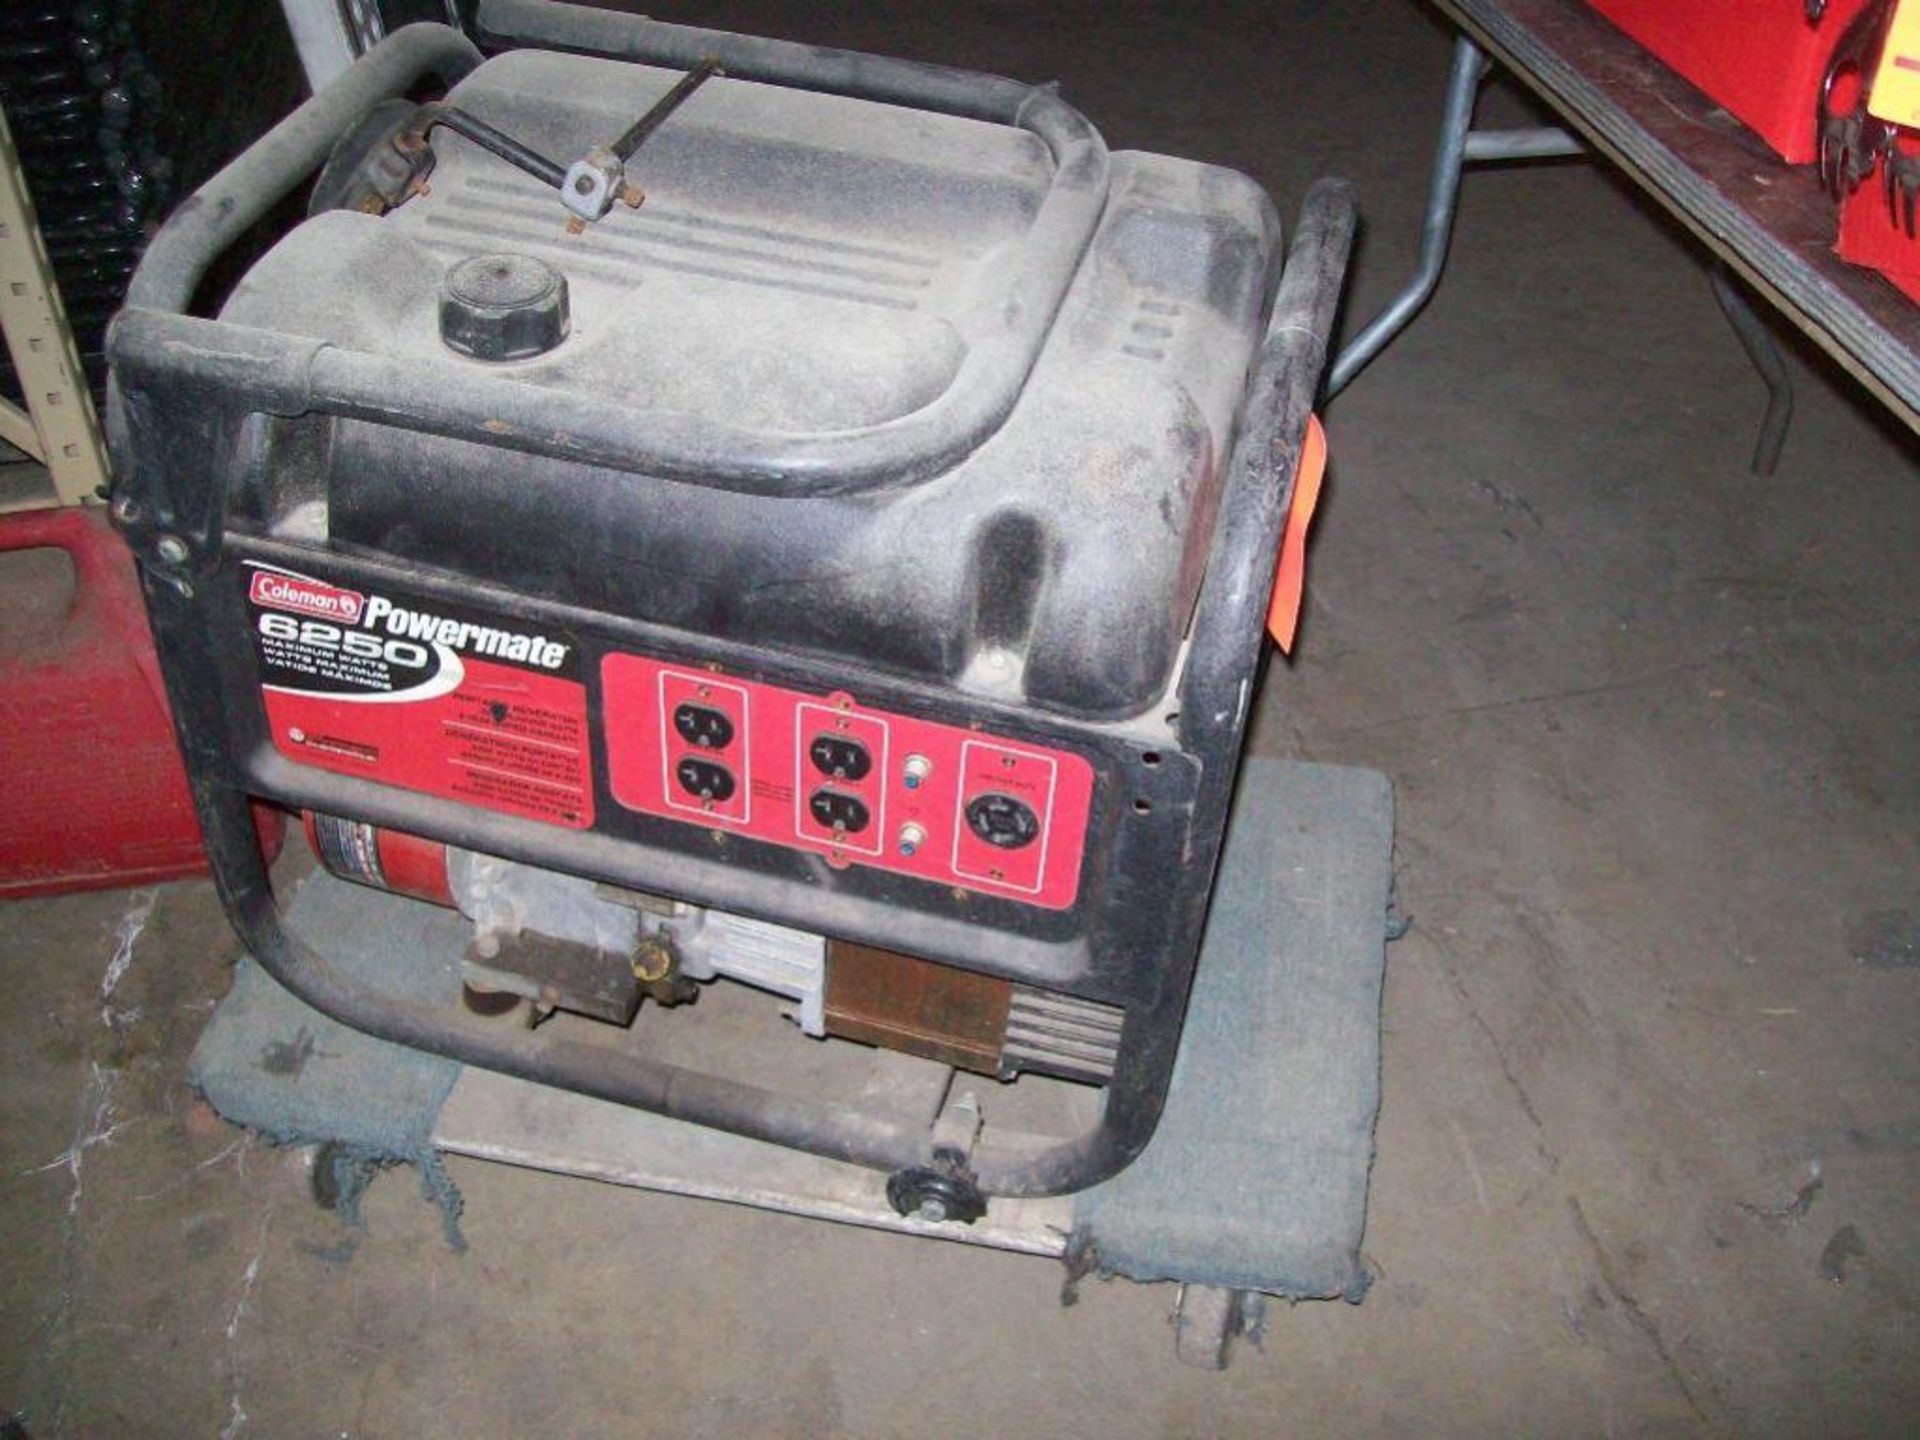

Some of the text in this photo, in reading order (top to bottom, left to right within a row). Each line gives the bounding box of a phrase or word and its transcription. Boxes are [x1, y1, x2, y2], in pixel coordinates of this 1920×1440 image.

[257, 576, 339, 610] Coleman
[258, 613, 428, 668] 6250
[363, 596, 566, 669] Powermate
[261, 637, 389, 672] MAXIMUM WATTS
[263, 648, 390, 680] WATTS MAXIMUM
[265, 657, 318, 675] VATIOS
